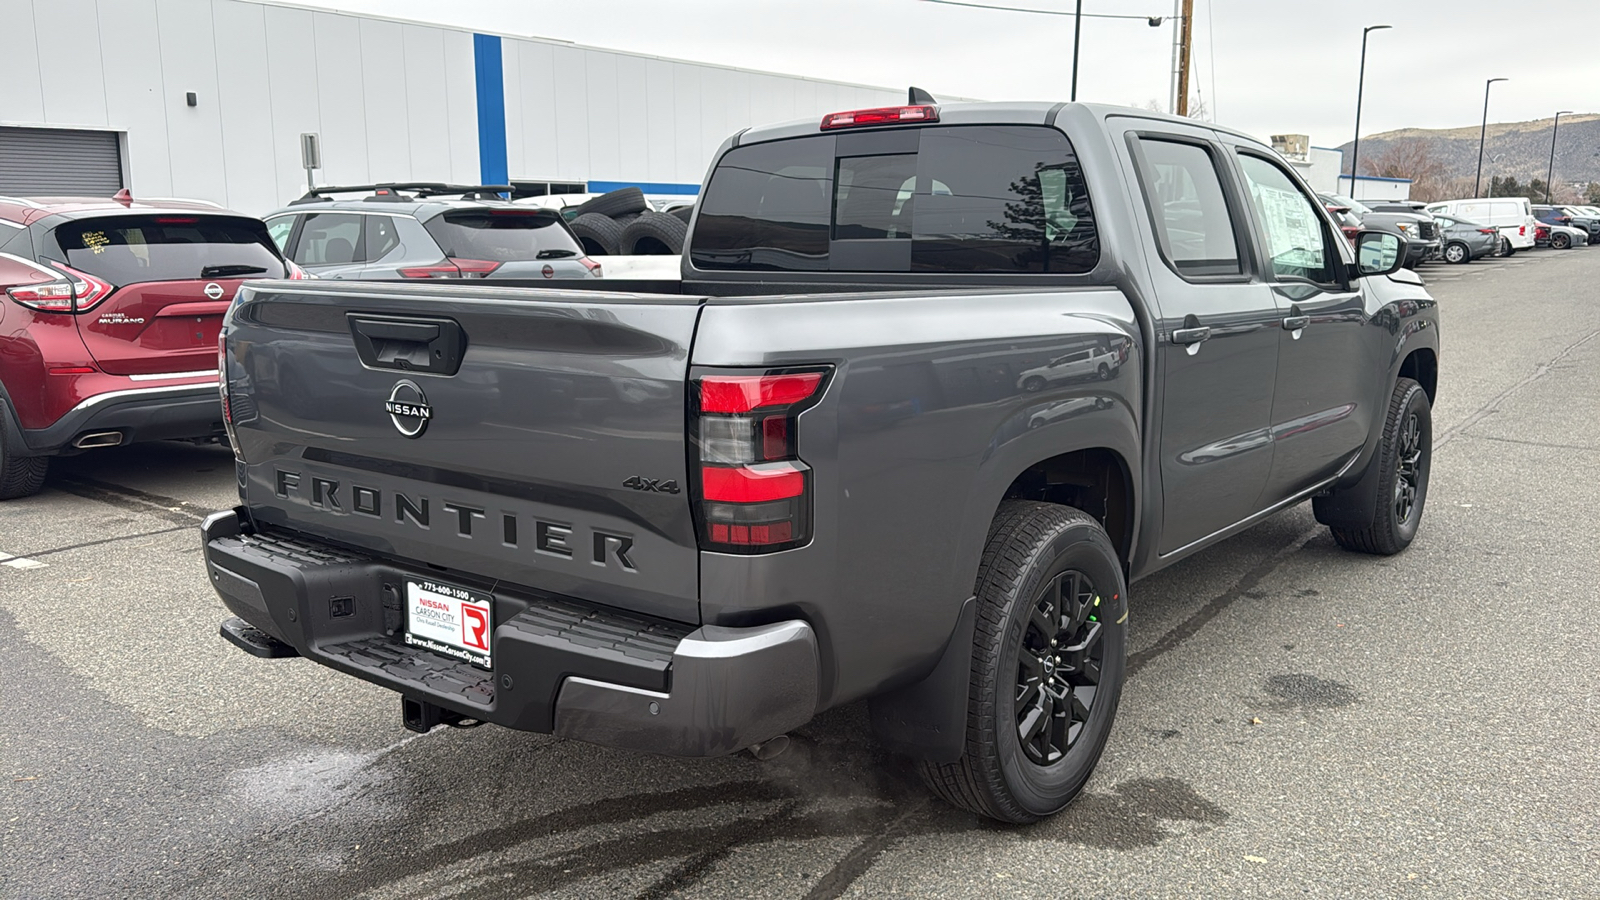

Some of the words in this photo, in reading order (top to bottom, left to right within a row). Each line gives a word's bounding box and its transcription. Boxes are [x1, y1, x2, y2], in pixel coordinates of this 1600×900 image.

[385, 402, 430, 418] NISSAN
[275, 468, 639, 573] FRONTIER
[423, 582, 469, 600] 775-600-1500
[419, 598, 449, 612] NISSAN
[415, 606, 441, 619] CARSON
[441, 612, 455, 623] CITY
[412, 638, 484, 664] www.NissanCarsonCity.com
